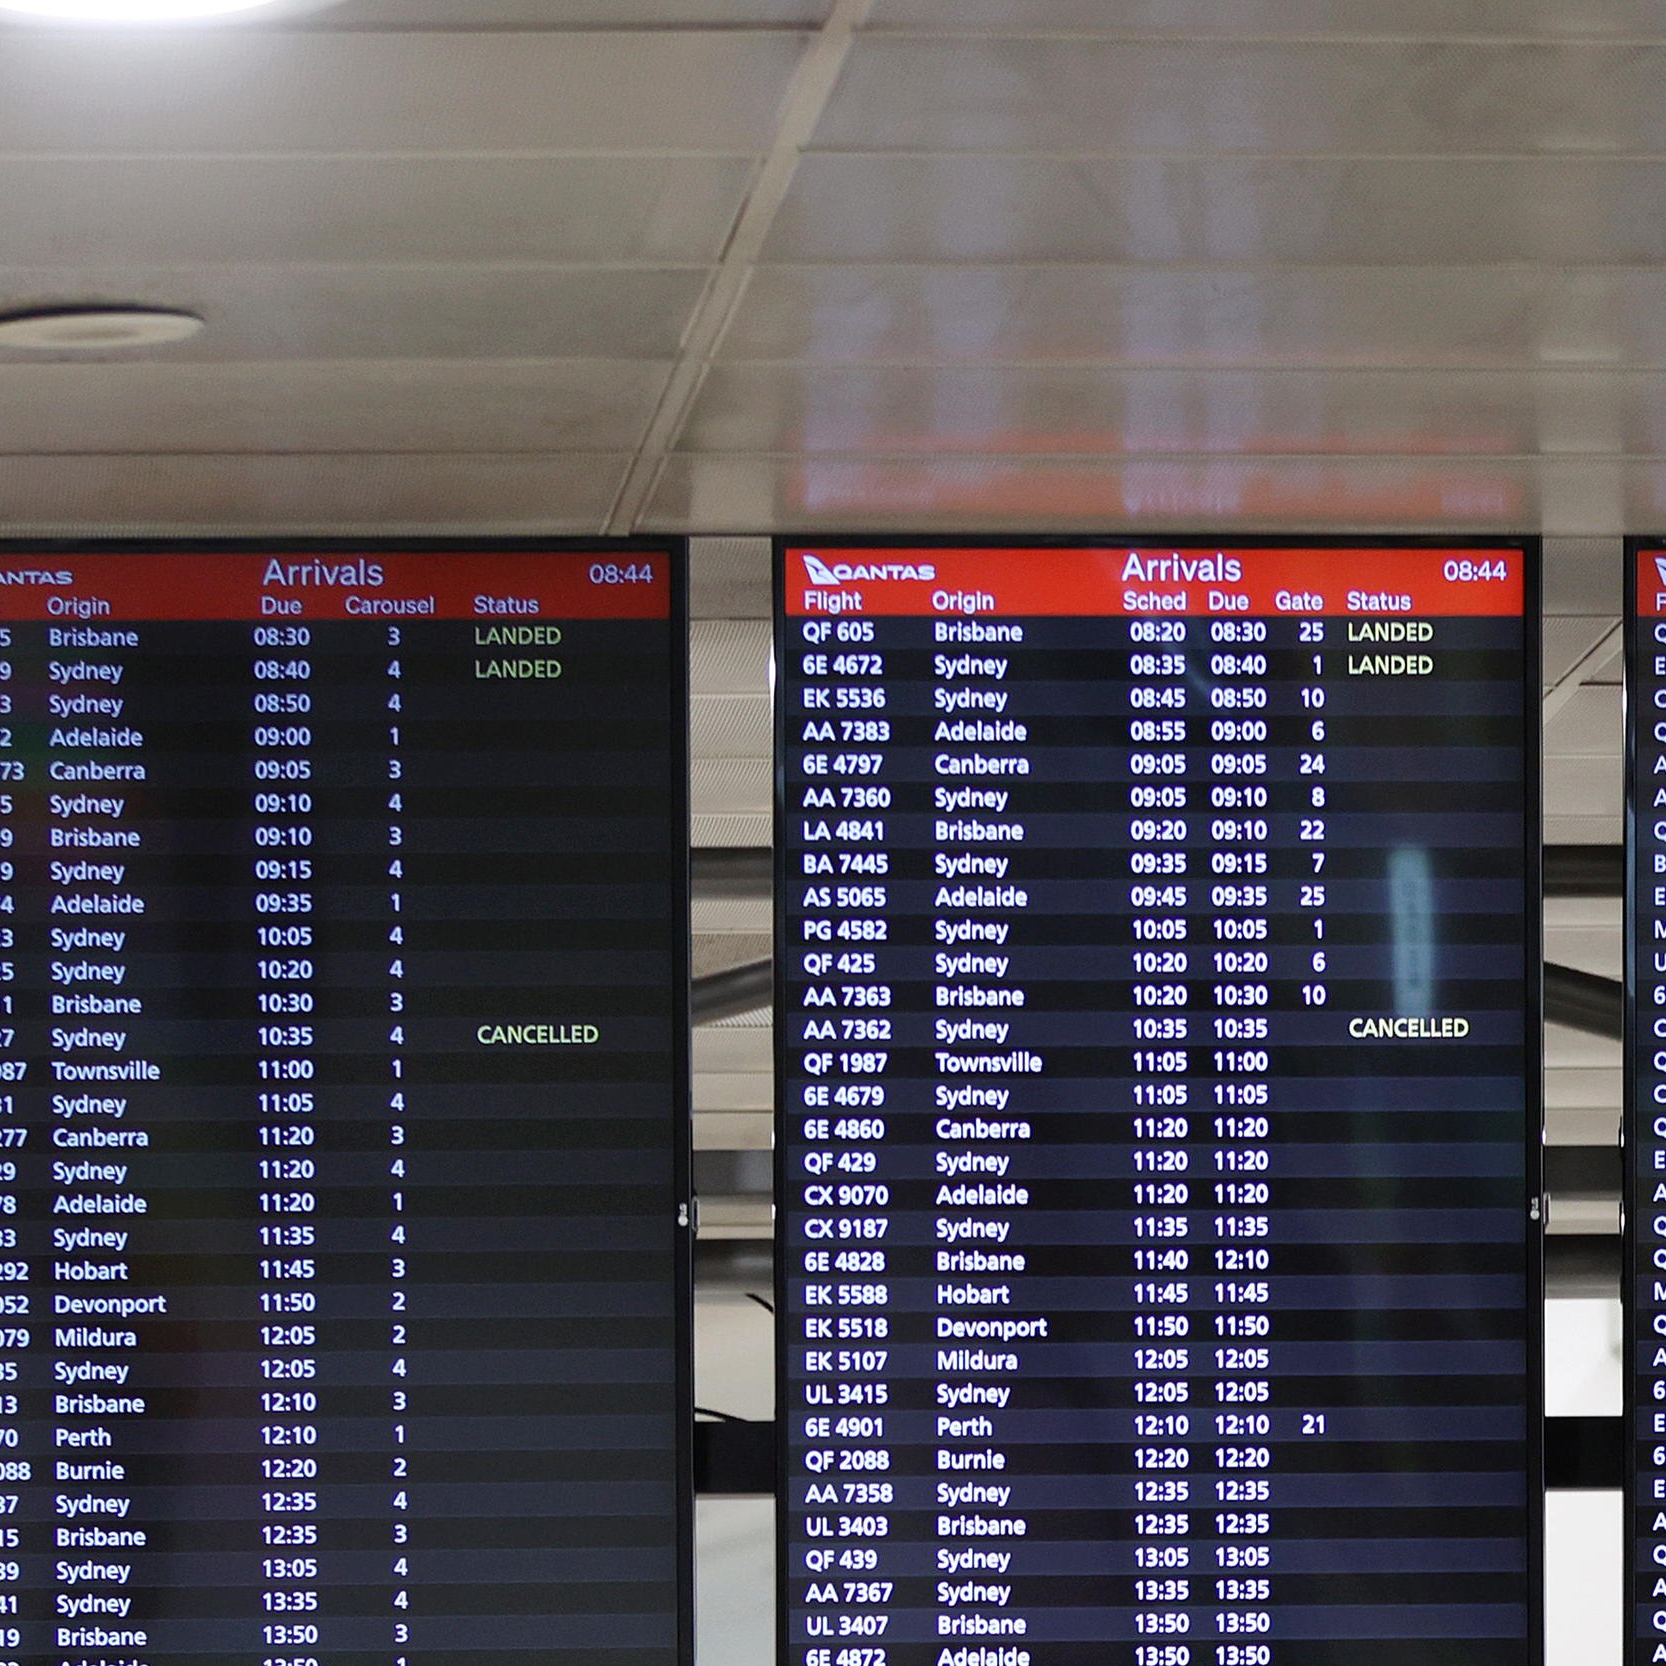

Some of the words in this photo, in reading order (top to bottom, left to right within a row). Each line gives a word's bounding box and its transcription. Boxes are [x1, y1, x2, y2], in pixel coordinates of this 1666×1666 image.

[263, 558, 384, 586] Arrivals
[589, 563, 654, 584] 08:44
[835, 564, 936, 584] QANTAS
[1121, 552, 1242, 582] Arrivals
[1443, 560, 1507, 581] 08:44
[47, 596, 110, 619] Origin
[261, 596, 303, 615] Due
[345, 595, 434, 615] Carousel
[474, 595, 539, 614] Status
[804, 590, 862, 615] Flight
[932, 590, 995, 615] Origin
[1123, 590, 1187, 611] Sched
[1208, 590, 1249, 611] Due
[1275, 590, 1324, 611] Gate
[1347, 590, 1412, 611] Status
[49, 627, 139, 647] Brisbane
[254, 627, 311, 646] 08:30
[388, 626, 401, 646] 3
[475, 626, 562, 645] LANDED
[802, 621, 832, 645] QF
[836, 621, 875, 642] 605
[935, 620, 1023, 642] Brisbane
[1130, 621, 1186, 642] 08:20
[1210, 621, 1267, 642] 08:30
[1299, 621, 1324, 642] 25
[1348, 622, 1434, 642] LANDED
[52, 1027, 127, 1052] Sydney
[258, 1026, 313, 1046] 10:35
[390, 1026, 404, 1045] 4
[477, 1024, 599, 1044] CANCELLED
[803, 1019, 837, 1040] AA
[841, 1019, 892, 1040] 7362
[935, 1018, 1009, 1044] Sydney
[1133, 1018, 1188, 1039] 10:35
[1213, 1018, 1268, 1039] 10:35
[1348, 1017, 1469, 1038] CANCELLED
[51, 1060, 161, 1081] Townsville
[258, 1059, 314, 1079] 11:00
[392, 1059, 401, 1078] 1
[54, 1295, 167, 1318] Devonport
[260, 1292, 316, 1312] 11:50
[392, 1291, 406, 1311] 2
[805, 1318, 833, 1338] EK
[838, 1317, 888, 1338] 5518
[937, 1317, 1048, 1342] Devonport
[1134, 1315, 1189, 1337] 11:50
[1214, 1315, 1270, 1336] 11:50
[805, 1417, 831, 1438] 6E
[835, 1417, 883, 1438] 4901
[937, 1415, 993, 1437] Perth
[1134, 1415, 1189, 1436] 12:10
[1215, 1414, 1270, 1435] 12:10
[1302, 1413, 1325, 1434] 21
